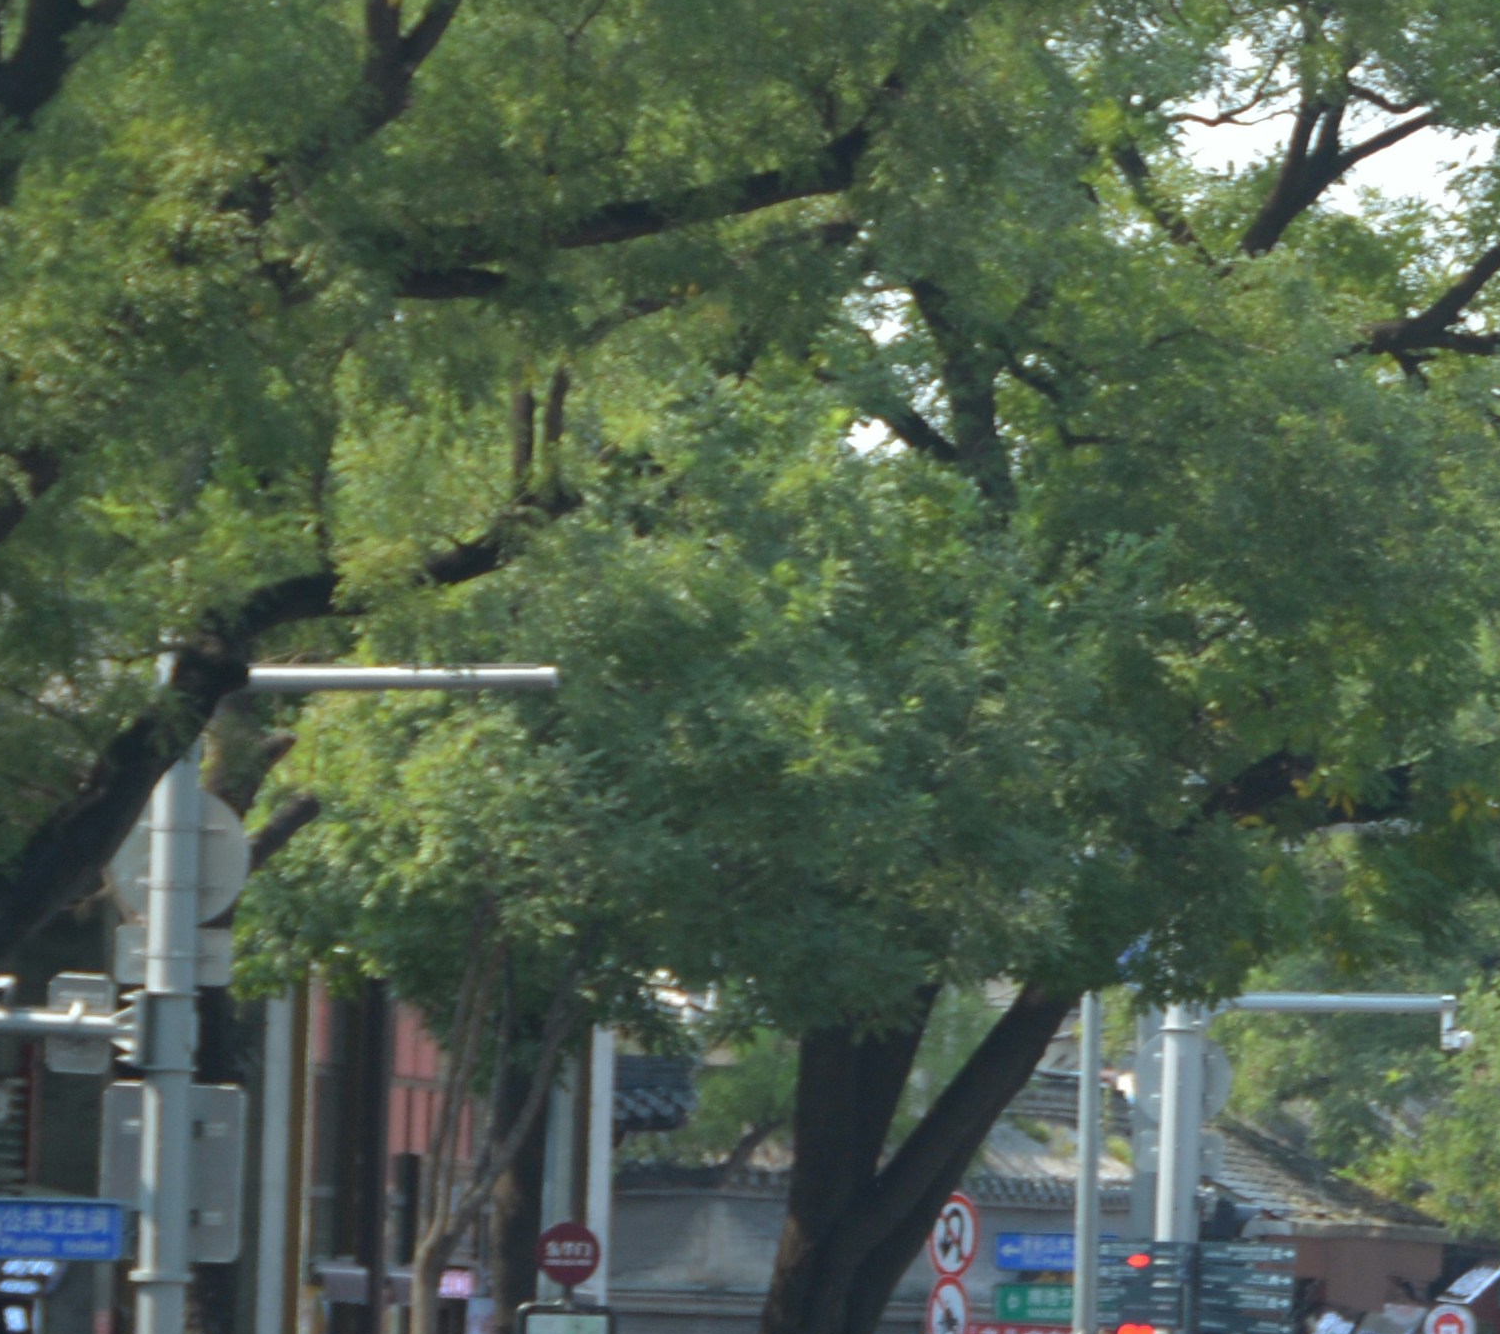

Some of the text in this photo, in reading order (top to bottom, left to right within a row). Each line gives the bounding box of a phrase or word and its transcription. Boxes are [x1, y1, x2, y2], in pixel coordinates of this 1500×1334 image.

[1, 1207, 109, 1234] 公共卫生间
